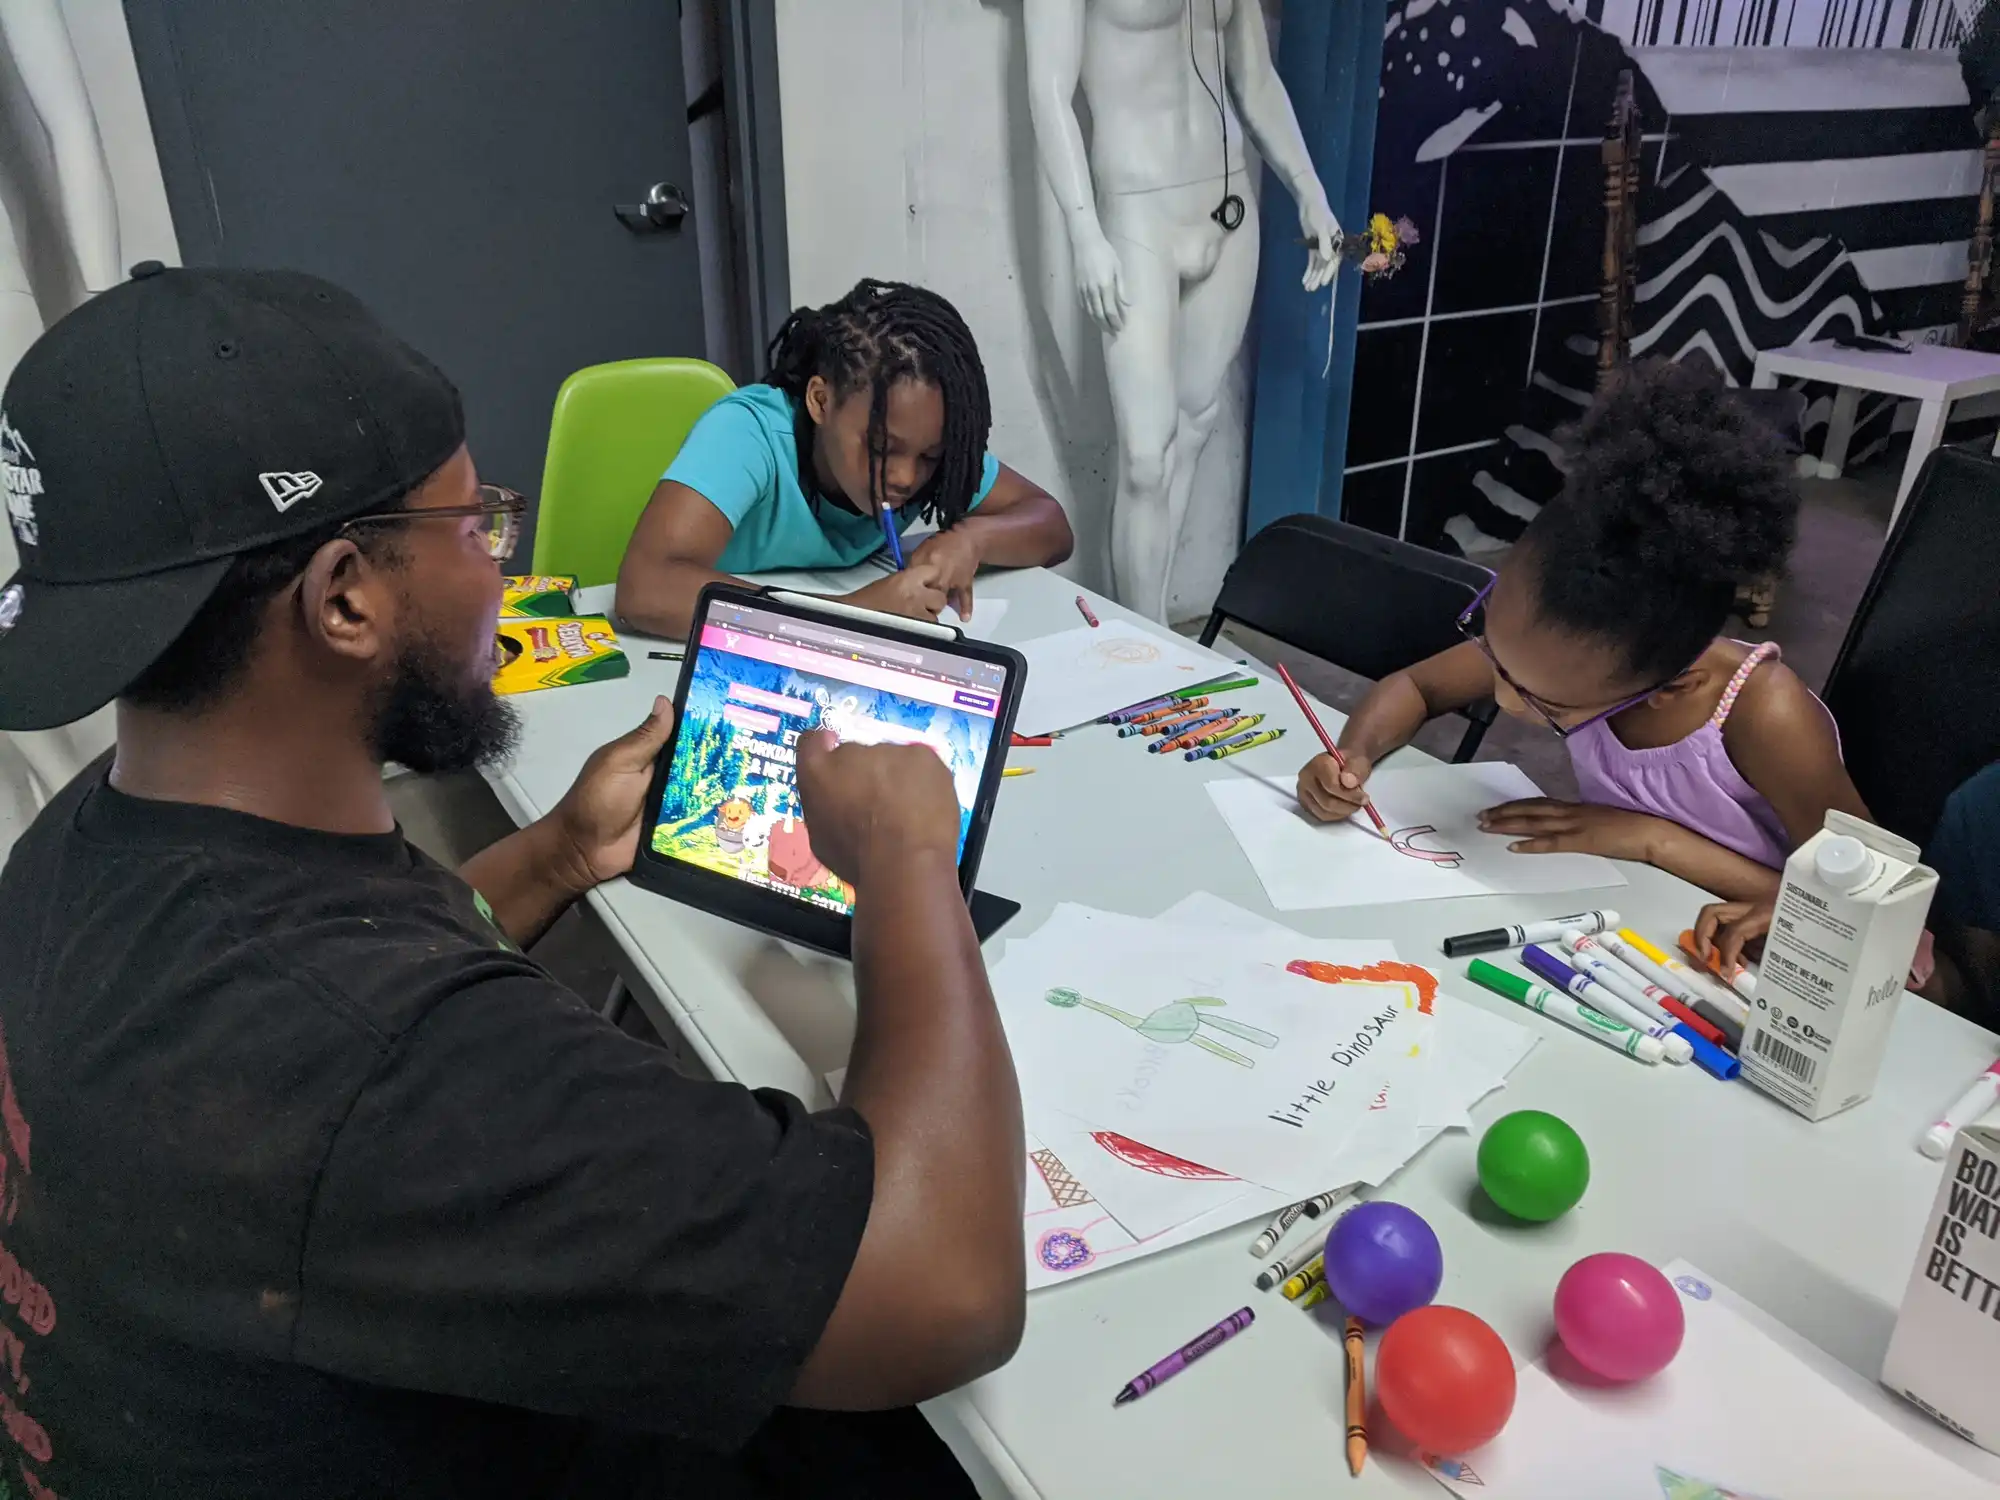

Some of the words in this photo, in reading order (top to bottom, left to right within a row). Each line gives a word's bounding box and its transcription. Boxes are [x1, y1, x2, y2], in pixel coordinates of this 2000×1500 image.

[732, 733, 797, 765] SPORKDA
[1268, 1079, 1335, 1128] little
[1935, 1213, 1967, 1257] IS
